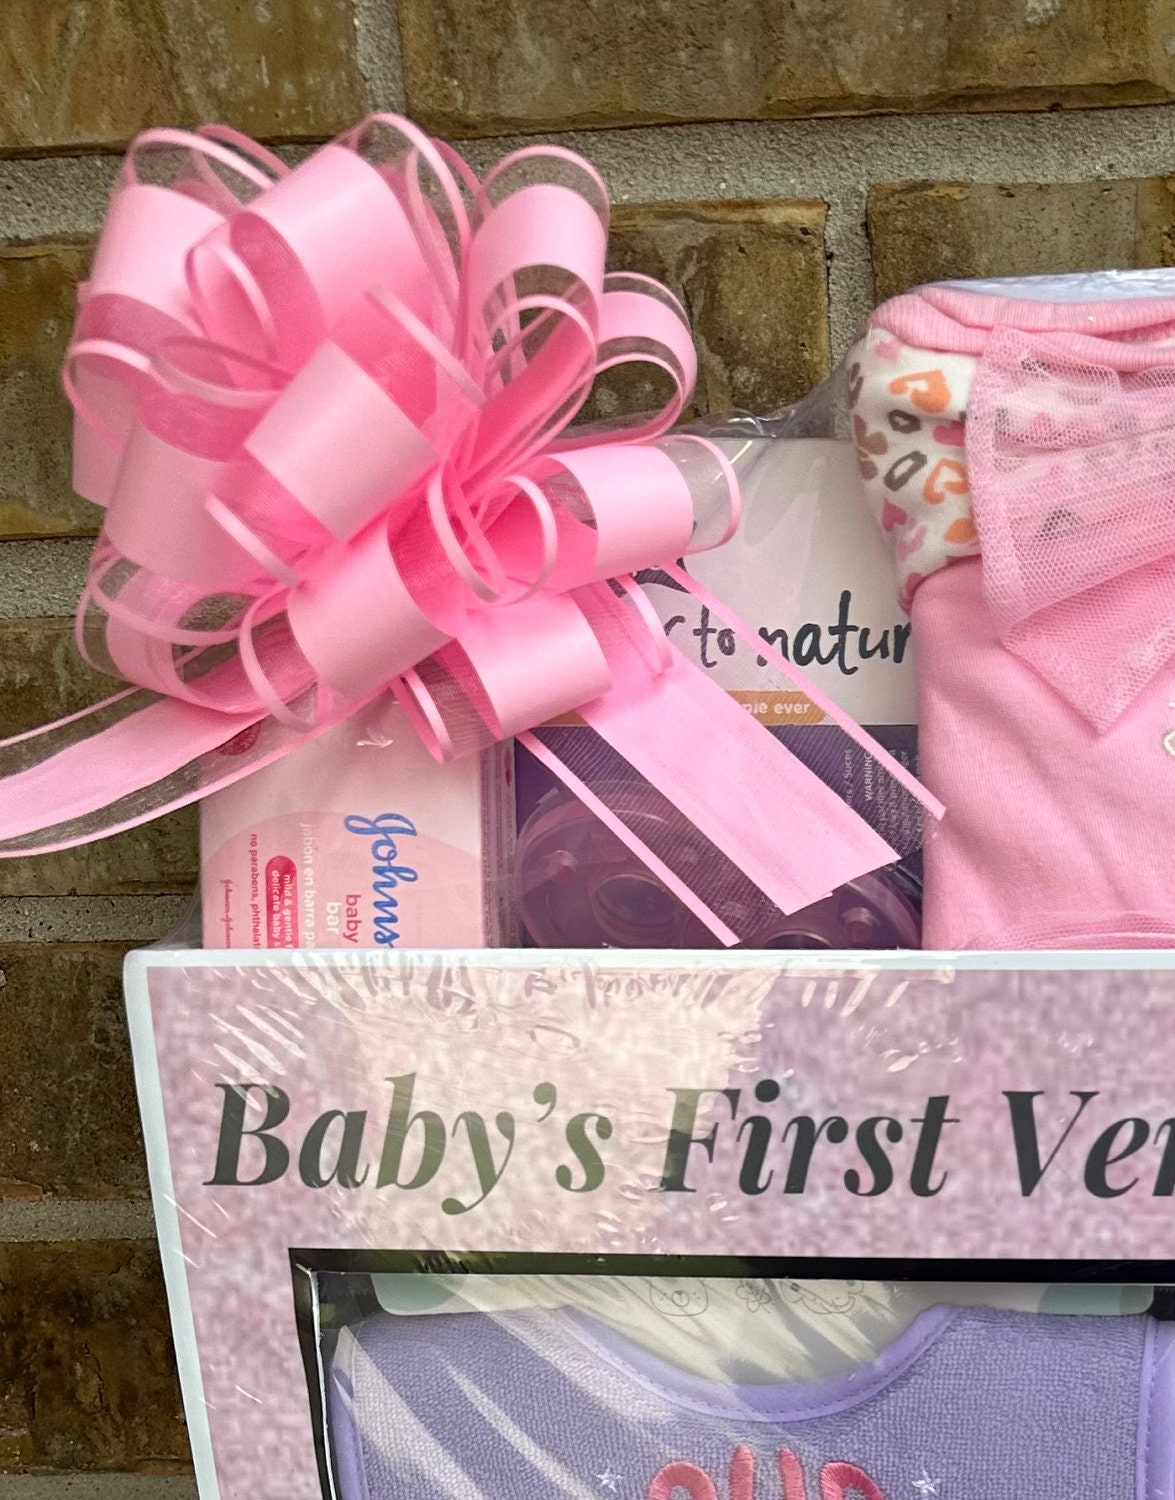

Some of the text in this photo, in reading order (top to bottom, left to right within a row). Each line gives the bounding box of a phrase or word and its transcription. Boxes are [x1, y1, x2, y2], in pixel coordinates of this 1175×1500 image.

[693, 589, 912, 676] to natur
[773, 701, 811, 715] ever
[250, 834, 259, 848] no
[271, 870, 282, 911] delicate
[304, 867, 313, 886] en
[344, 812, 418, 948] Johns
[249, 903, 262, 948] phthalat
[270, 913, 282, 939] baby
[282, 909, 294, 942] gentle
[304, 890, 316, 927] barra
[326, 902, 341, 935] bar
[345, 894, 362, 943] baby
[302, 932, 315, 948] pa
[203, 1072, 614, 1215] Baby's
[657, 1079, 962, 1197] First
